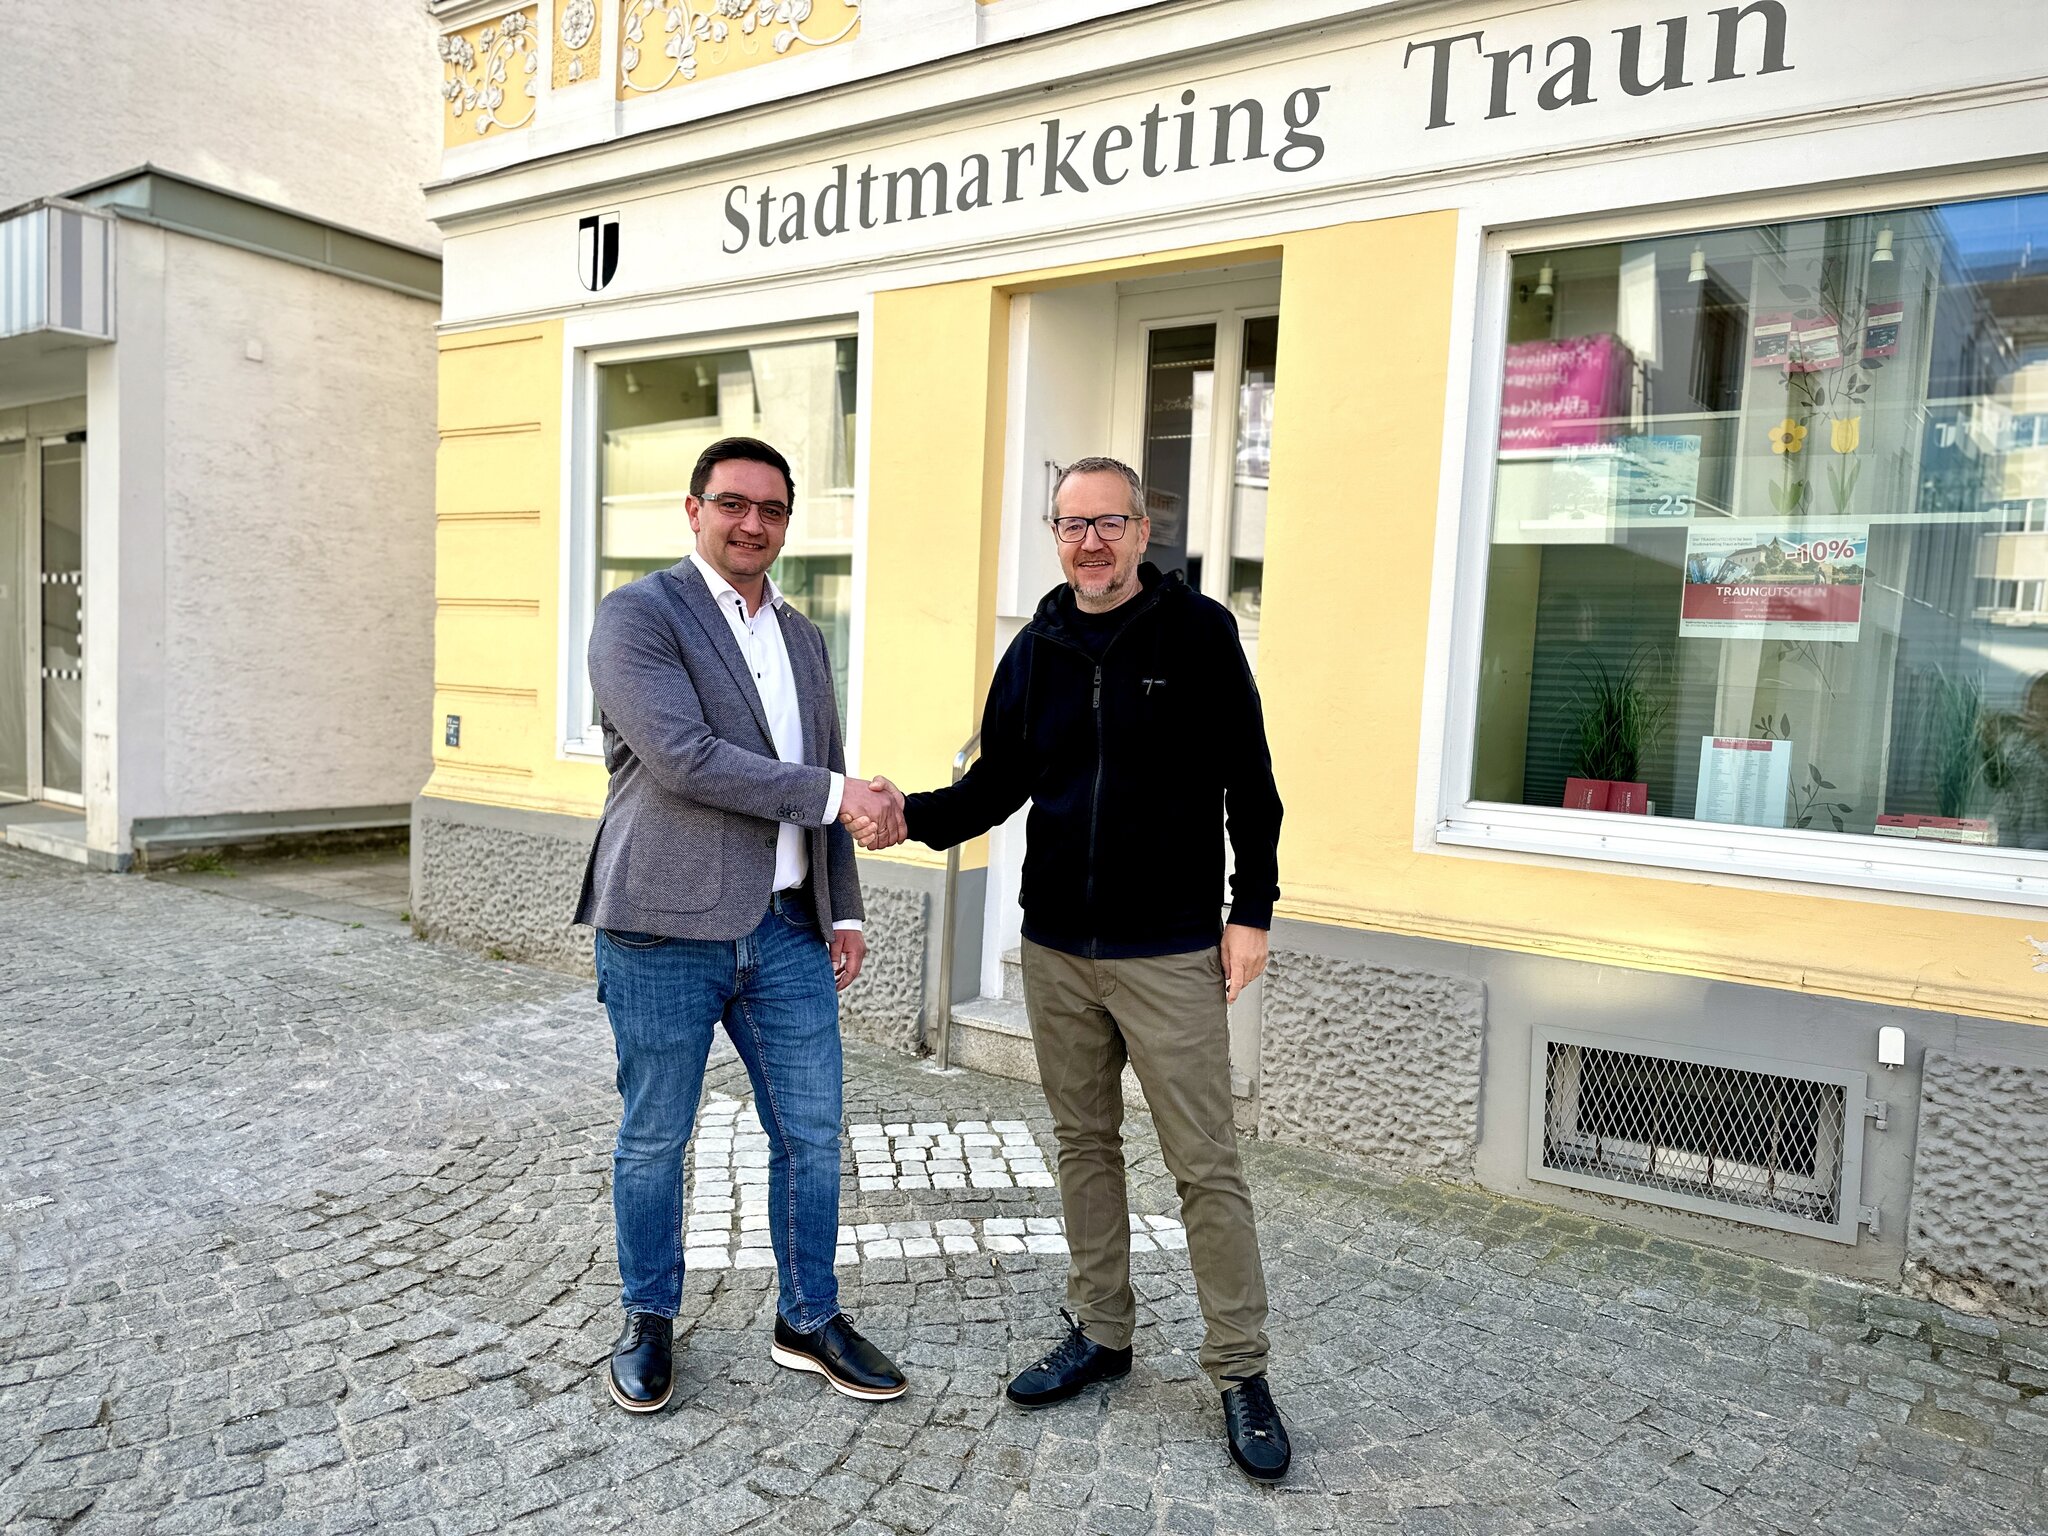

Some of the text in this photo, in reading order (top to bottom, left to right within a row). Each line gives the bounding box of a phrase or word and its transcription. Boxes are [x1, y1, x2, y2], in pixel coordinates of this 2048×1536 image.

[722, 0, 1795, 254] Stadtmarketing Traun
[1785, 539, 1856, 564] -10%
[1716, 586, 1828, 598] TRAUNGUTSCHEIN
